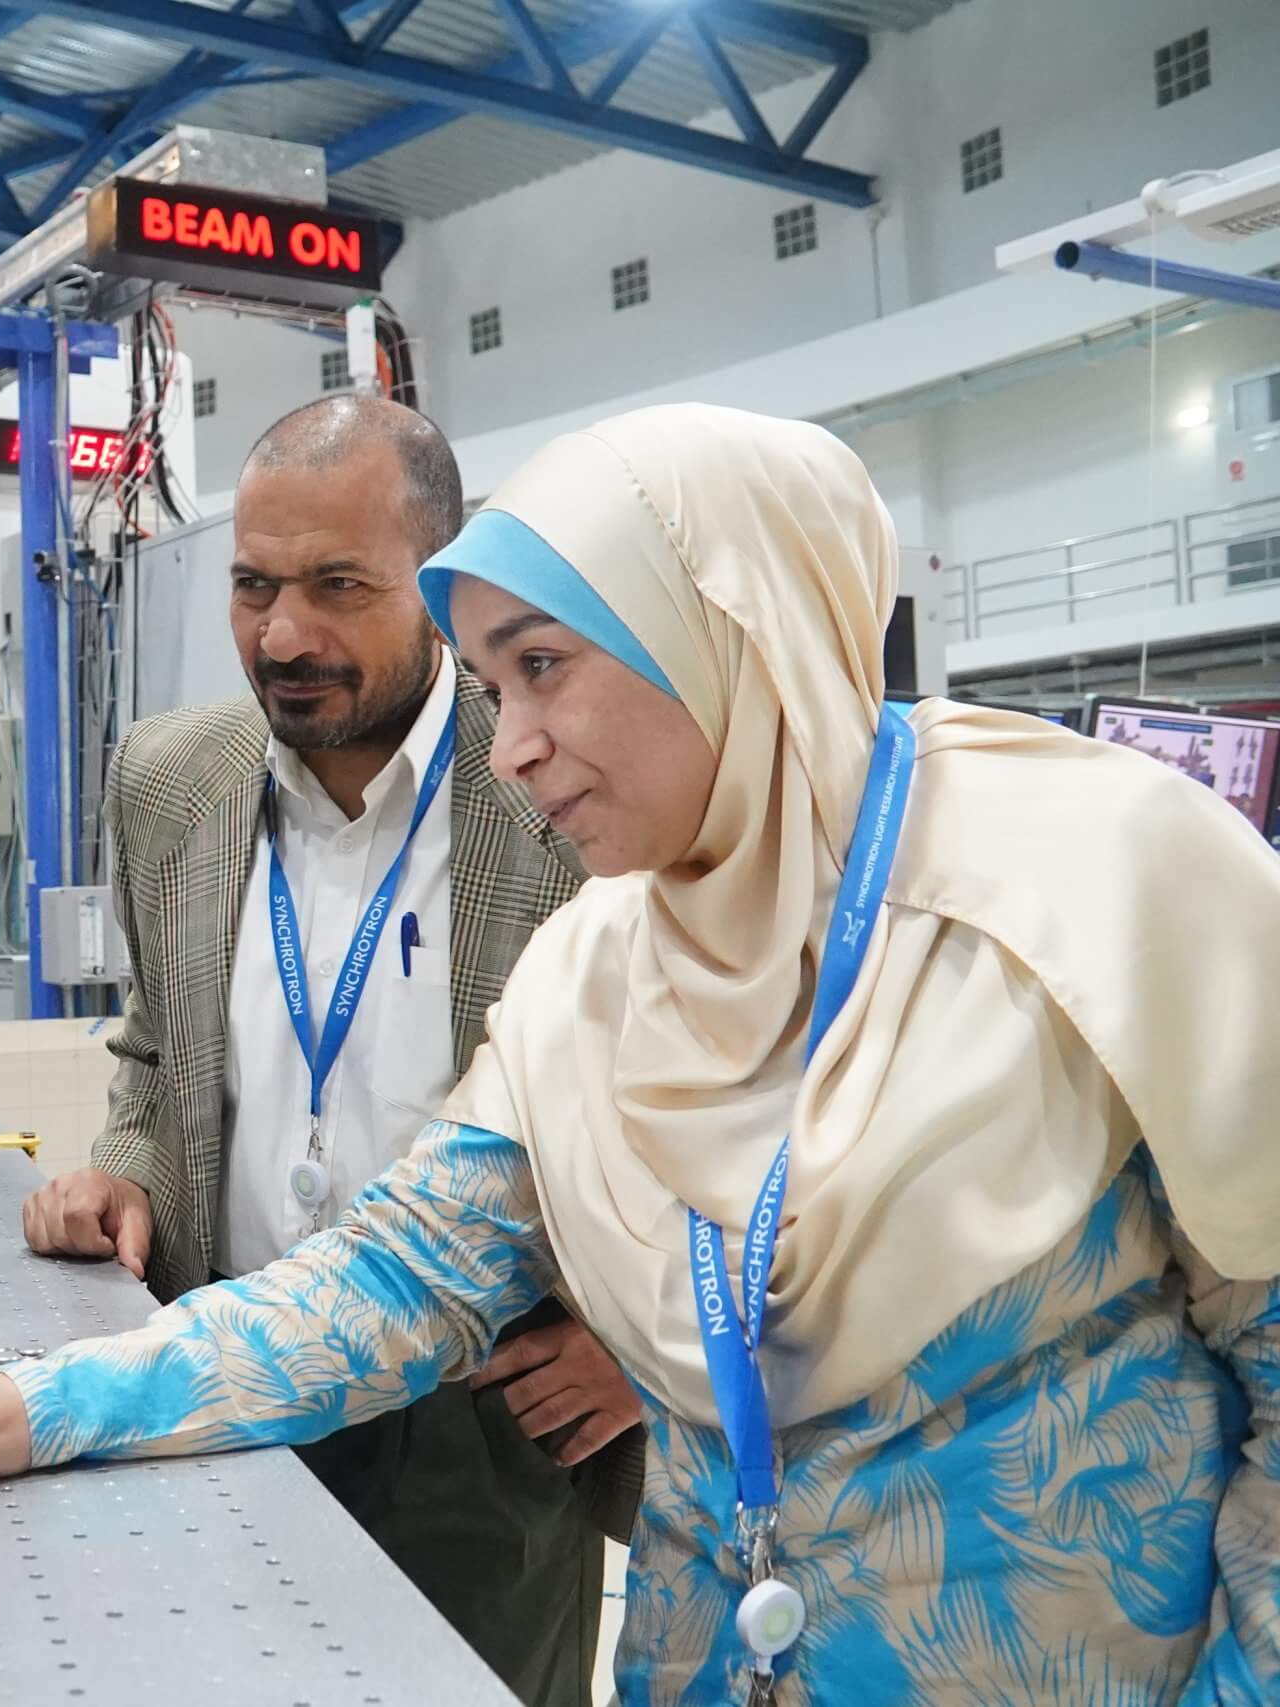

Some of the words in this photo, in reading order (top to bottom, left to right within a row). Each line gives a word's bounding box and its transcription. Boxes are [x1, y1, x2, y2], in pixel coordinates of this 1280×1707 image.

[142, 196, 274, 258] BEAM
[288, 222, 362, 273] ON
[873, 815, 888, 842] LIGHT
[880, 773, 897, 815] RESEARCH
[855, 841, 882, 909] SYNCHROTRON
[273, 894, 303, 1017] SYNCHROTRON
[334, 894, 388, 1017] SYNCHROTRON
[694, 1211, 730, 1337] HROTRON
